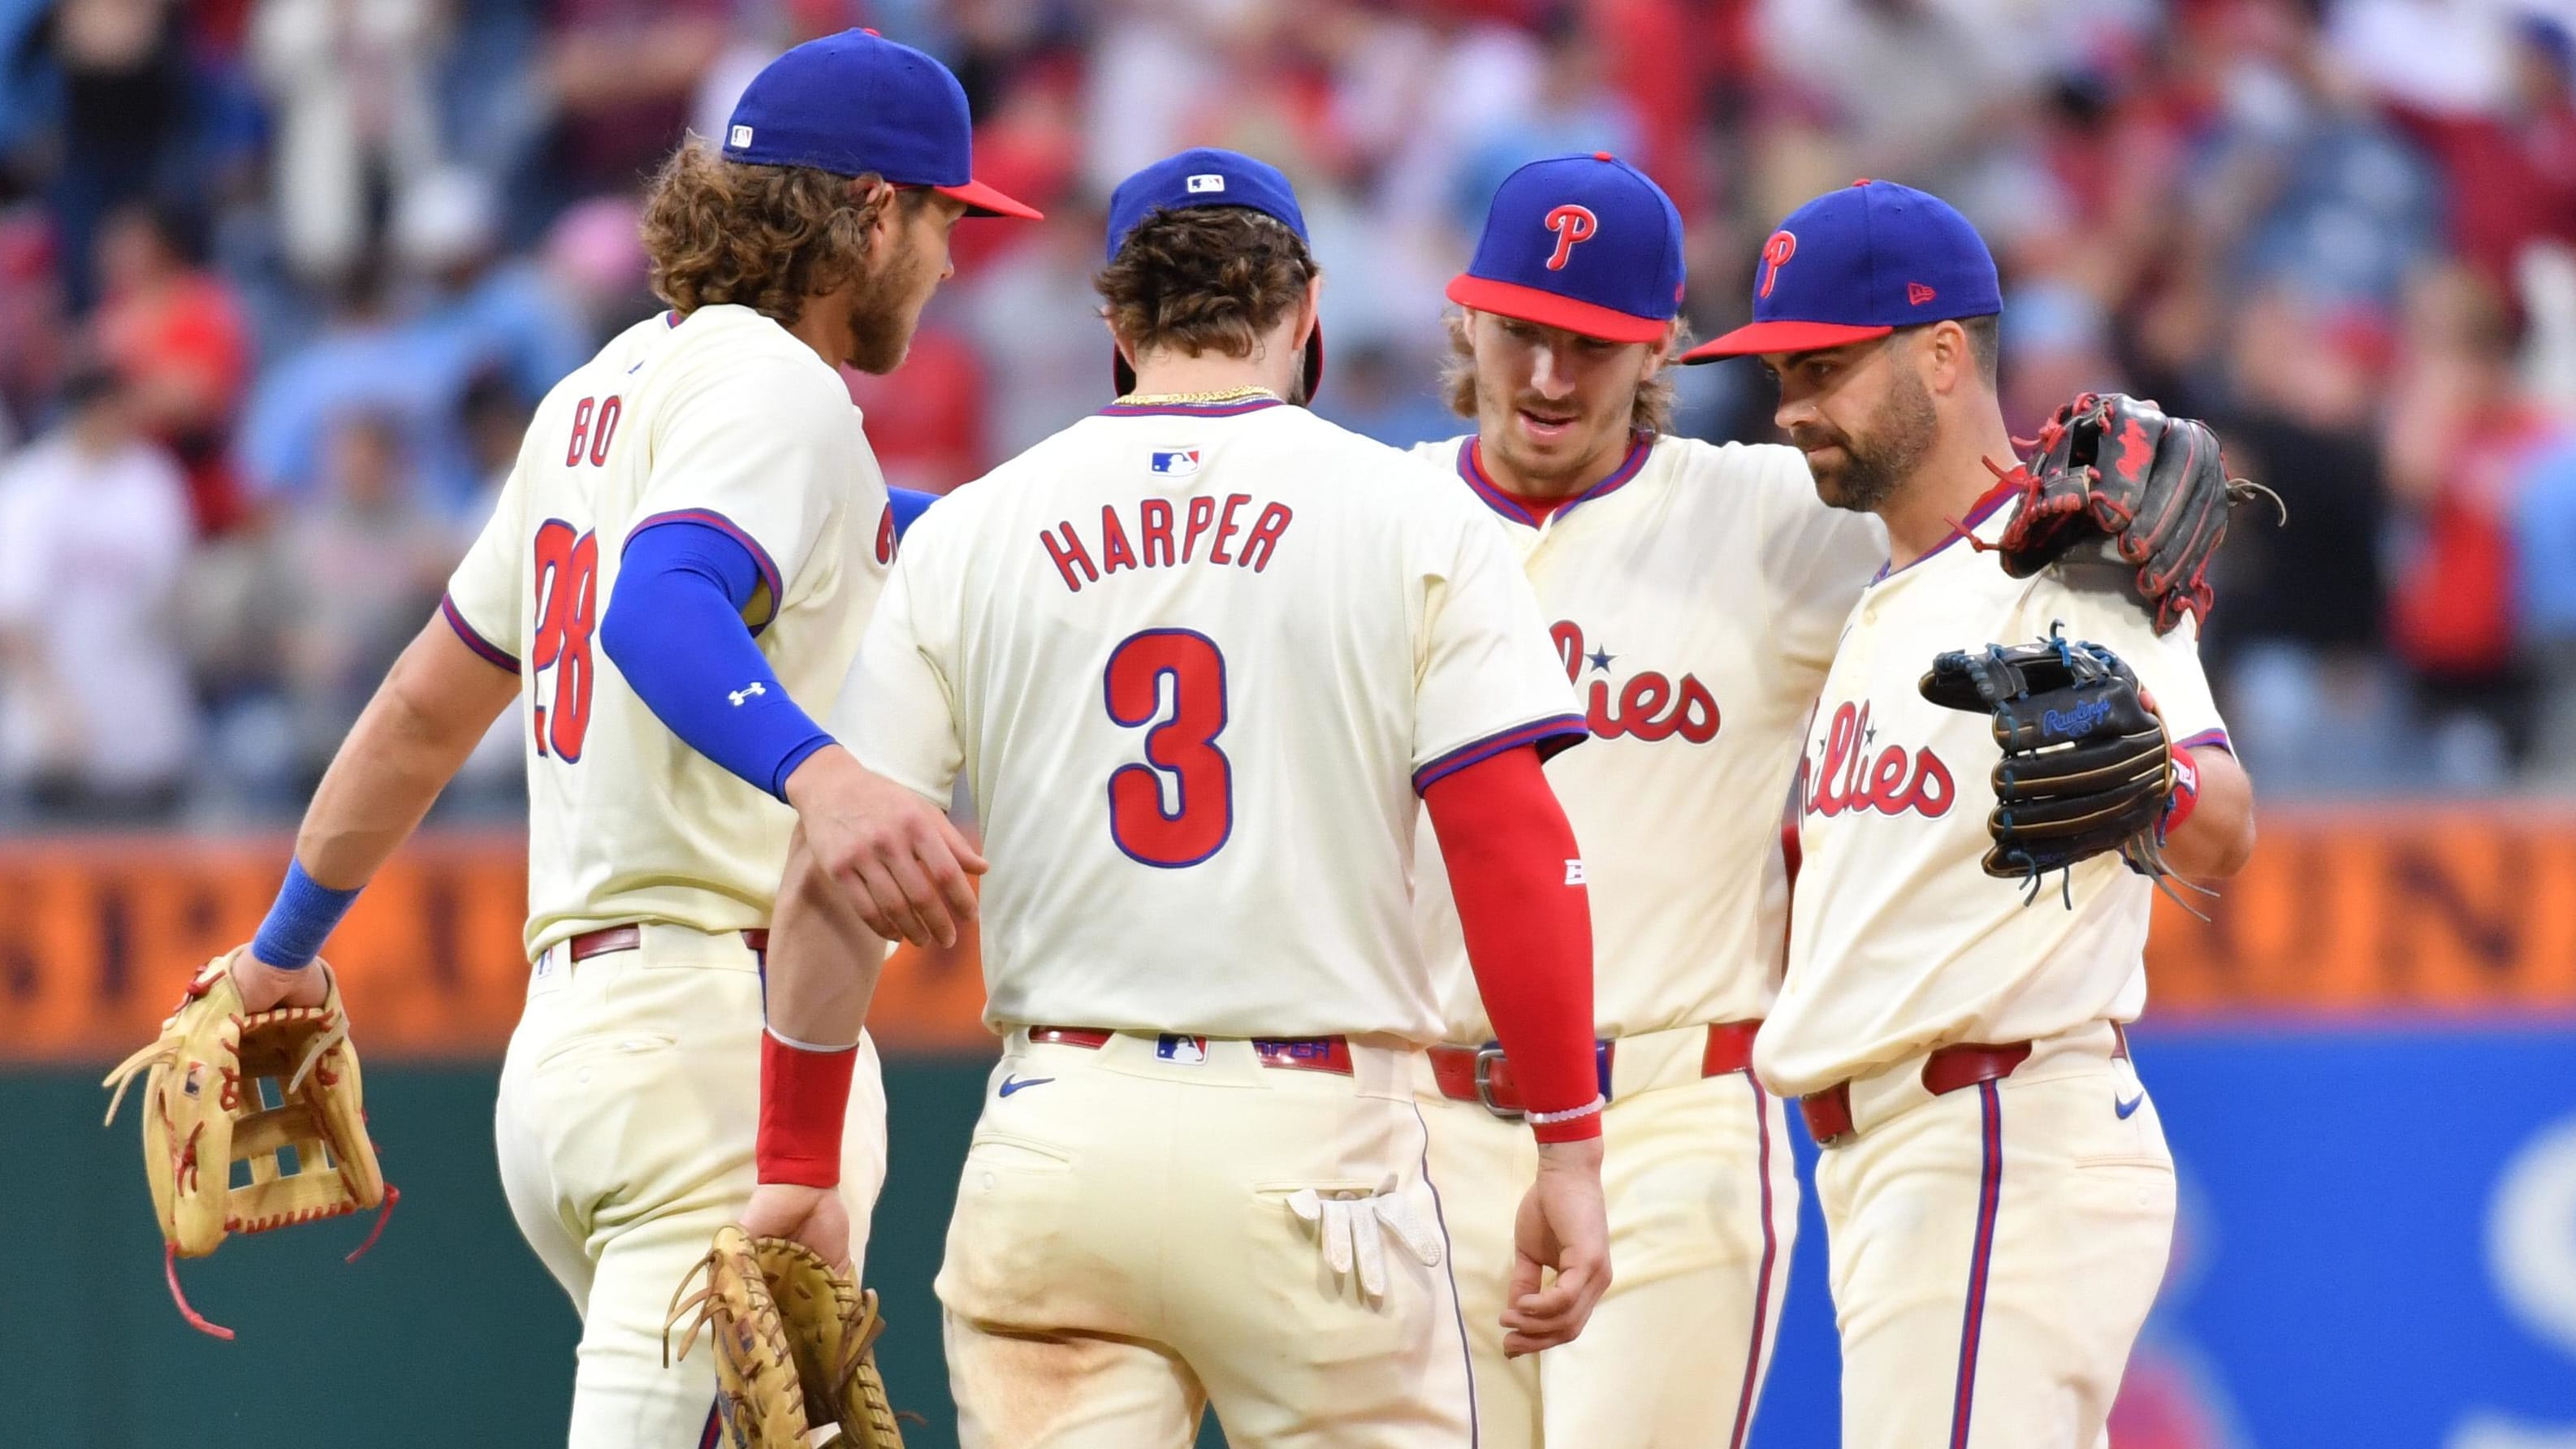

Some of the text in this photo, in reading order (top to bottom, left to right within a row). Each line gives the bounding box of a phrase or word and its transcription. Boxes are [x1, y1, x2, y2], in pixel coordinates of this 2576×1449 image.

[1545, 204, 1597, 270] P
[1760, 230, 1797, 299] P
[1039, 493, 1293, 592] HARPER
[533, 517, 599, 765] 28
[1104, 627, 1234, 869] 3
